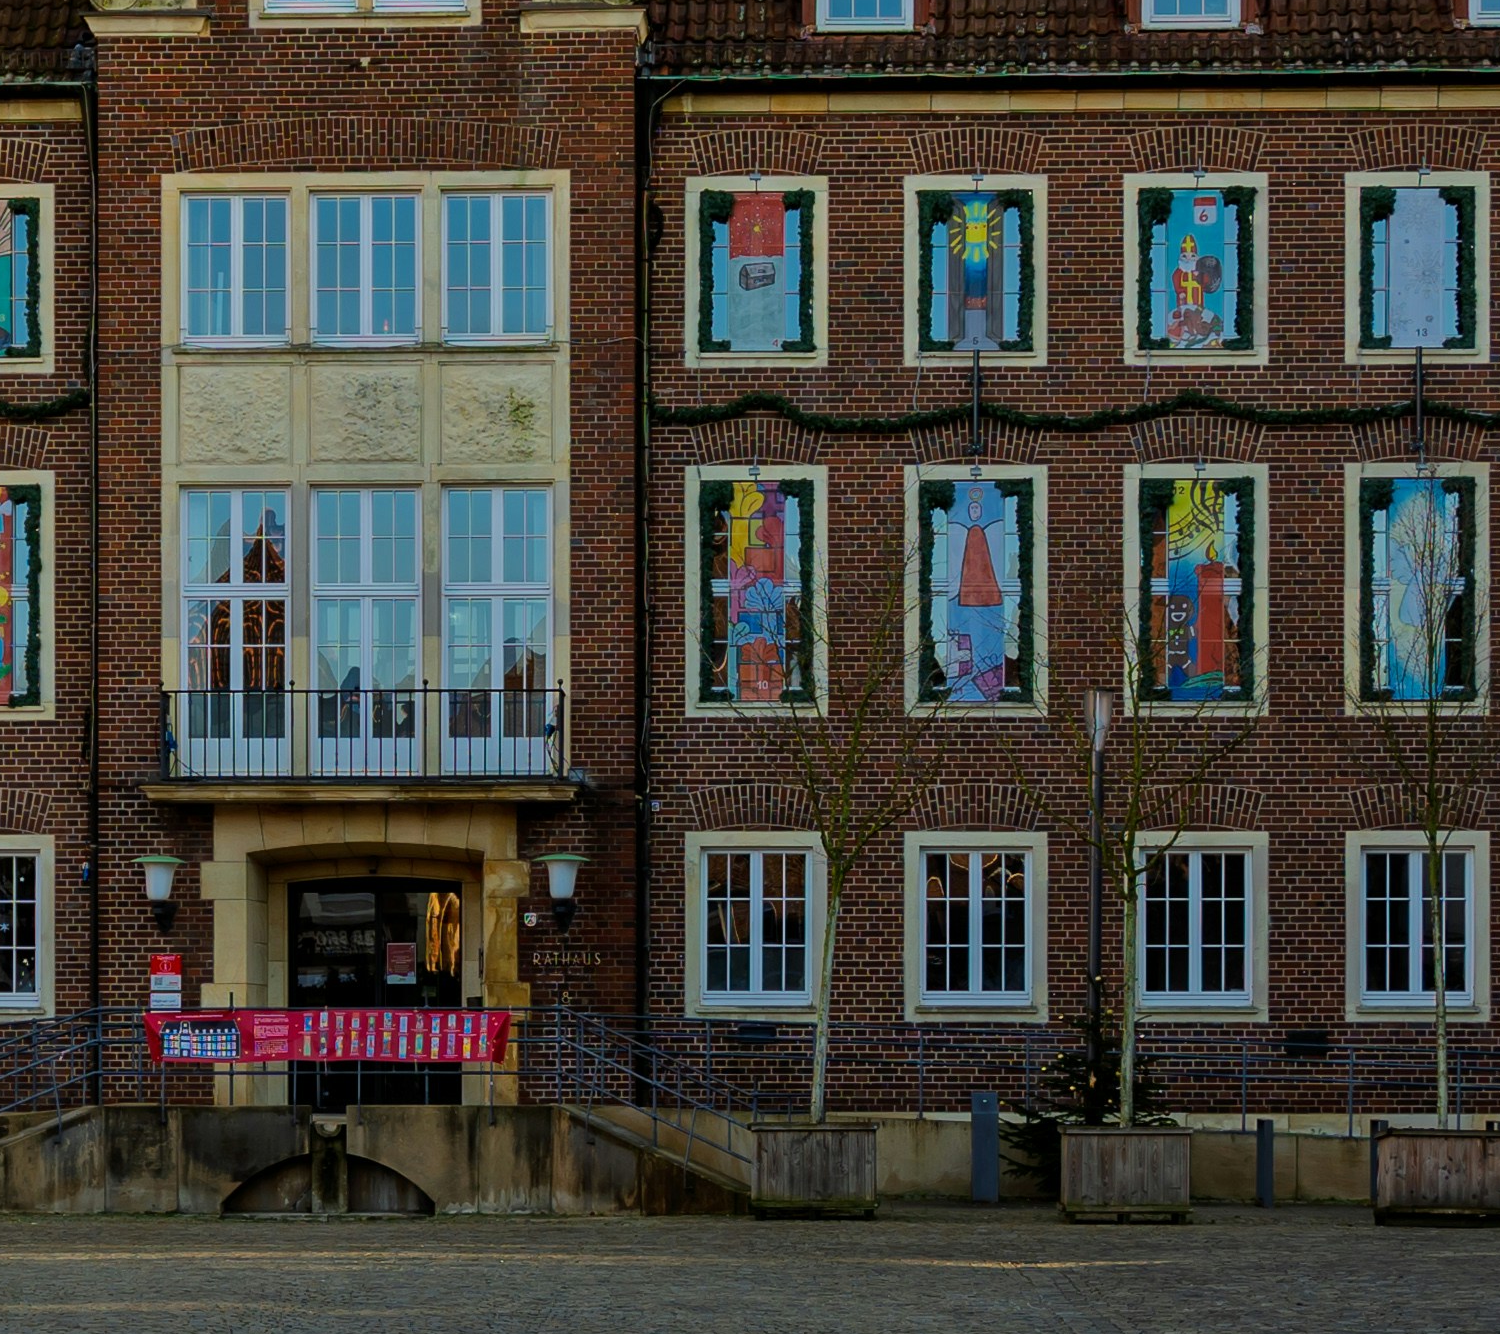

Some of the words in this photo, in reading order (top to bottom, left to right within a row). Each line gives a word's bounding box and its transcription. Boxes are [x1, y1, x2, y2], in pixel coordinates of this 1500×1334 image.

[1199, 209, 1208, 222] 6
[1415, 328, 1428, 337] 13
[772, 339, 779, 347] 4
[757, 681, 768, 689] 10
[532, 952, 602, 966] RATHAUS
